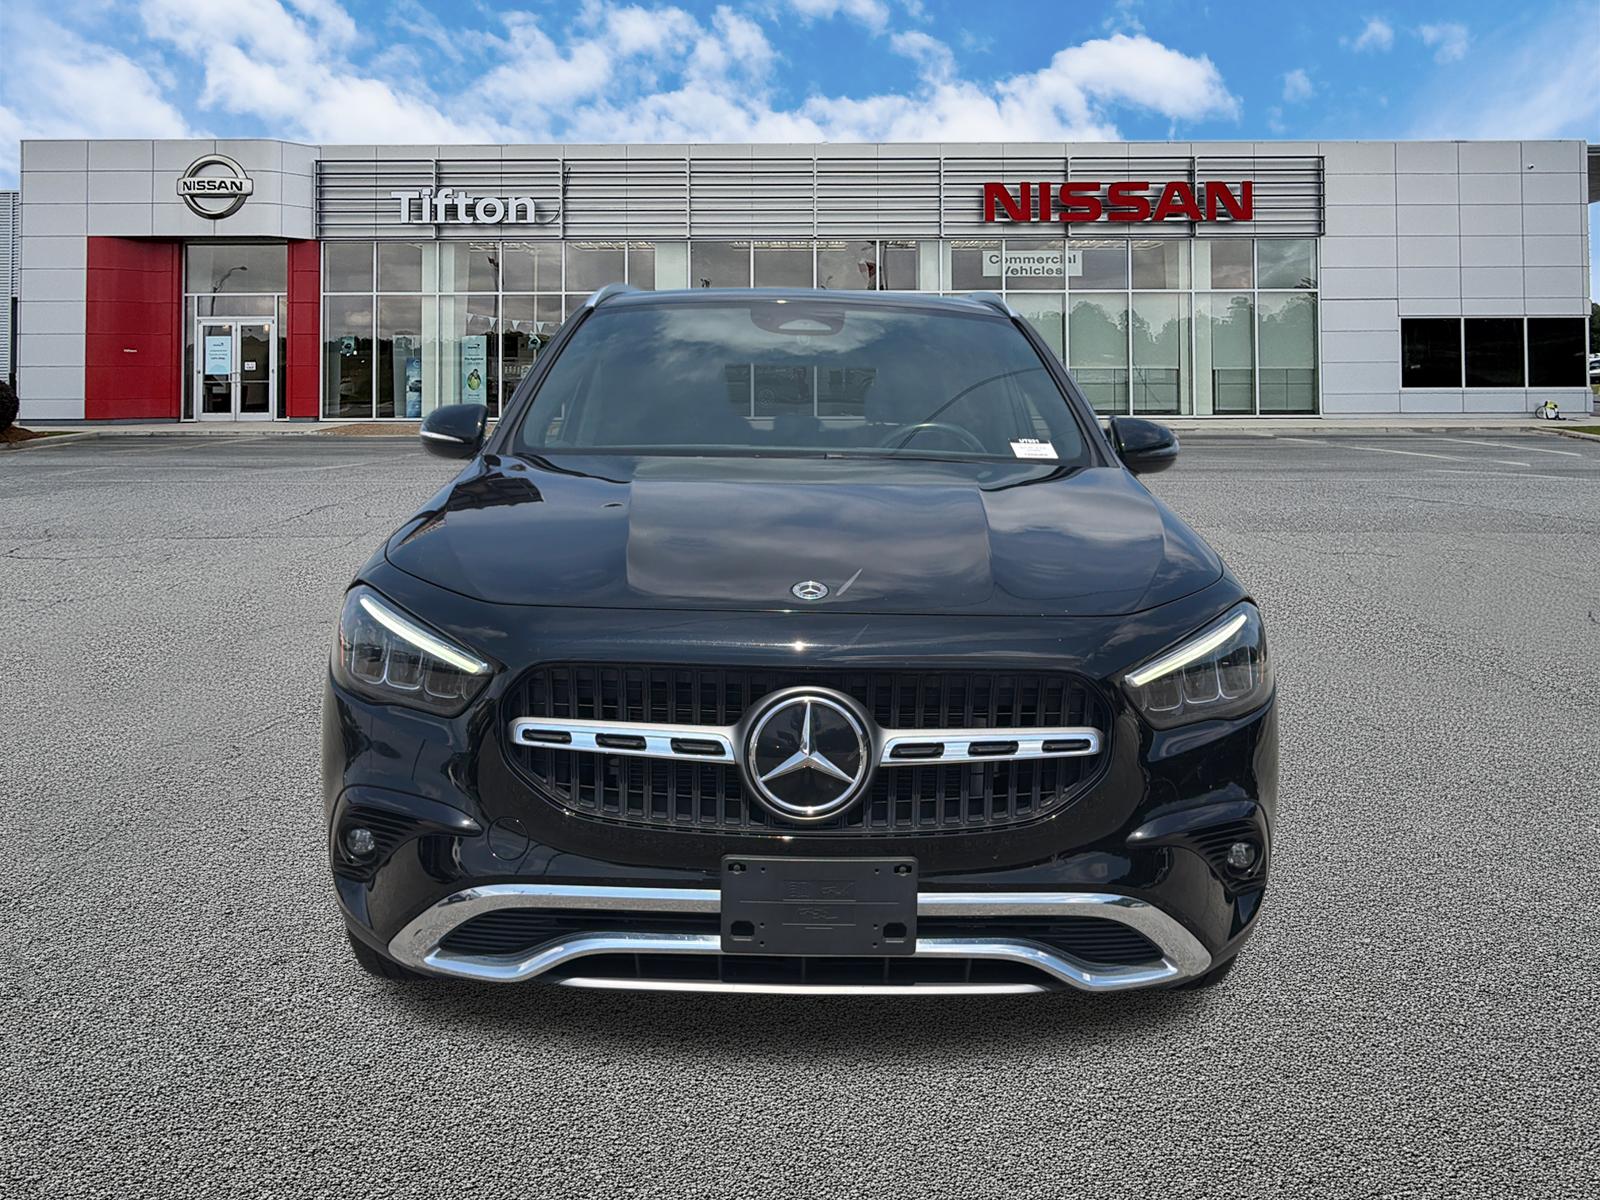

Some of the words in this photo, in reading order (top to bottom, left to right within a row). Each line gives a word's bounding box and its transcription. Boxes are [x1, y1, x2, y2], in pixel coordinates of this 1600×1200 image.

[183, 180, 243, 191] NISSAN
[984, 181, 1253, 222] NISSAN
[391, 188, 536, 224] Tifton
